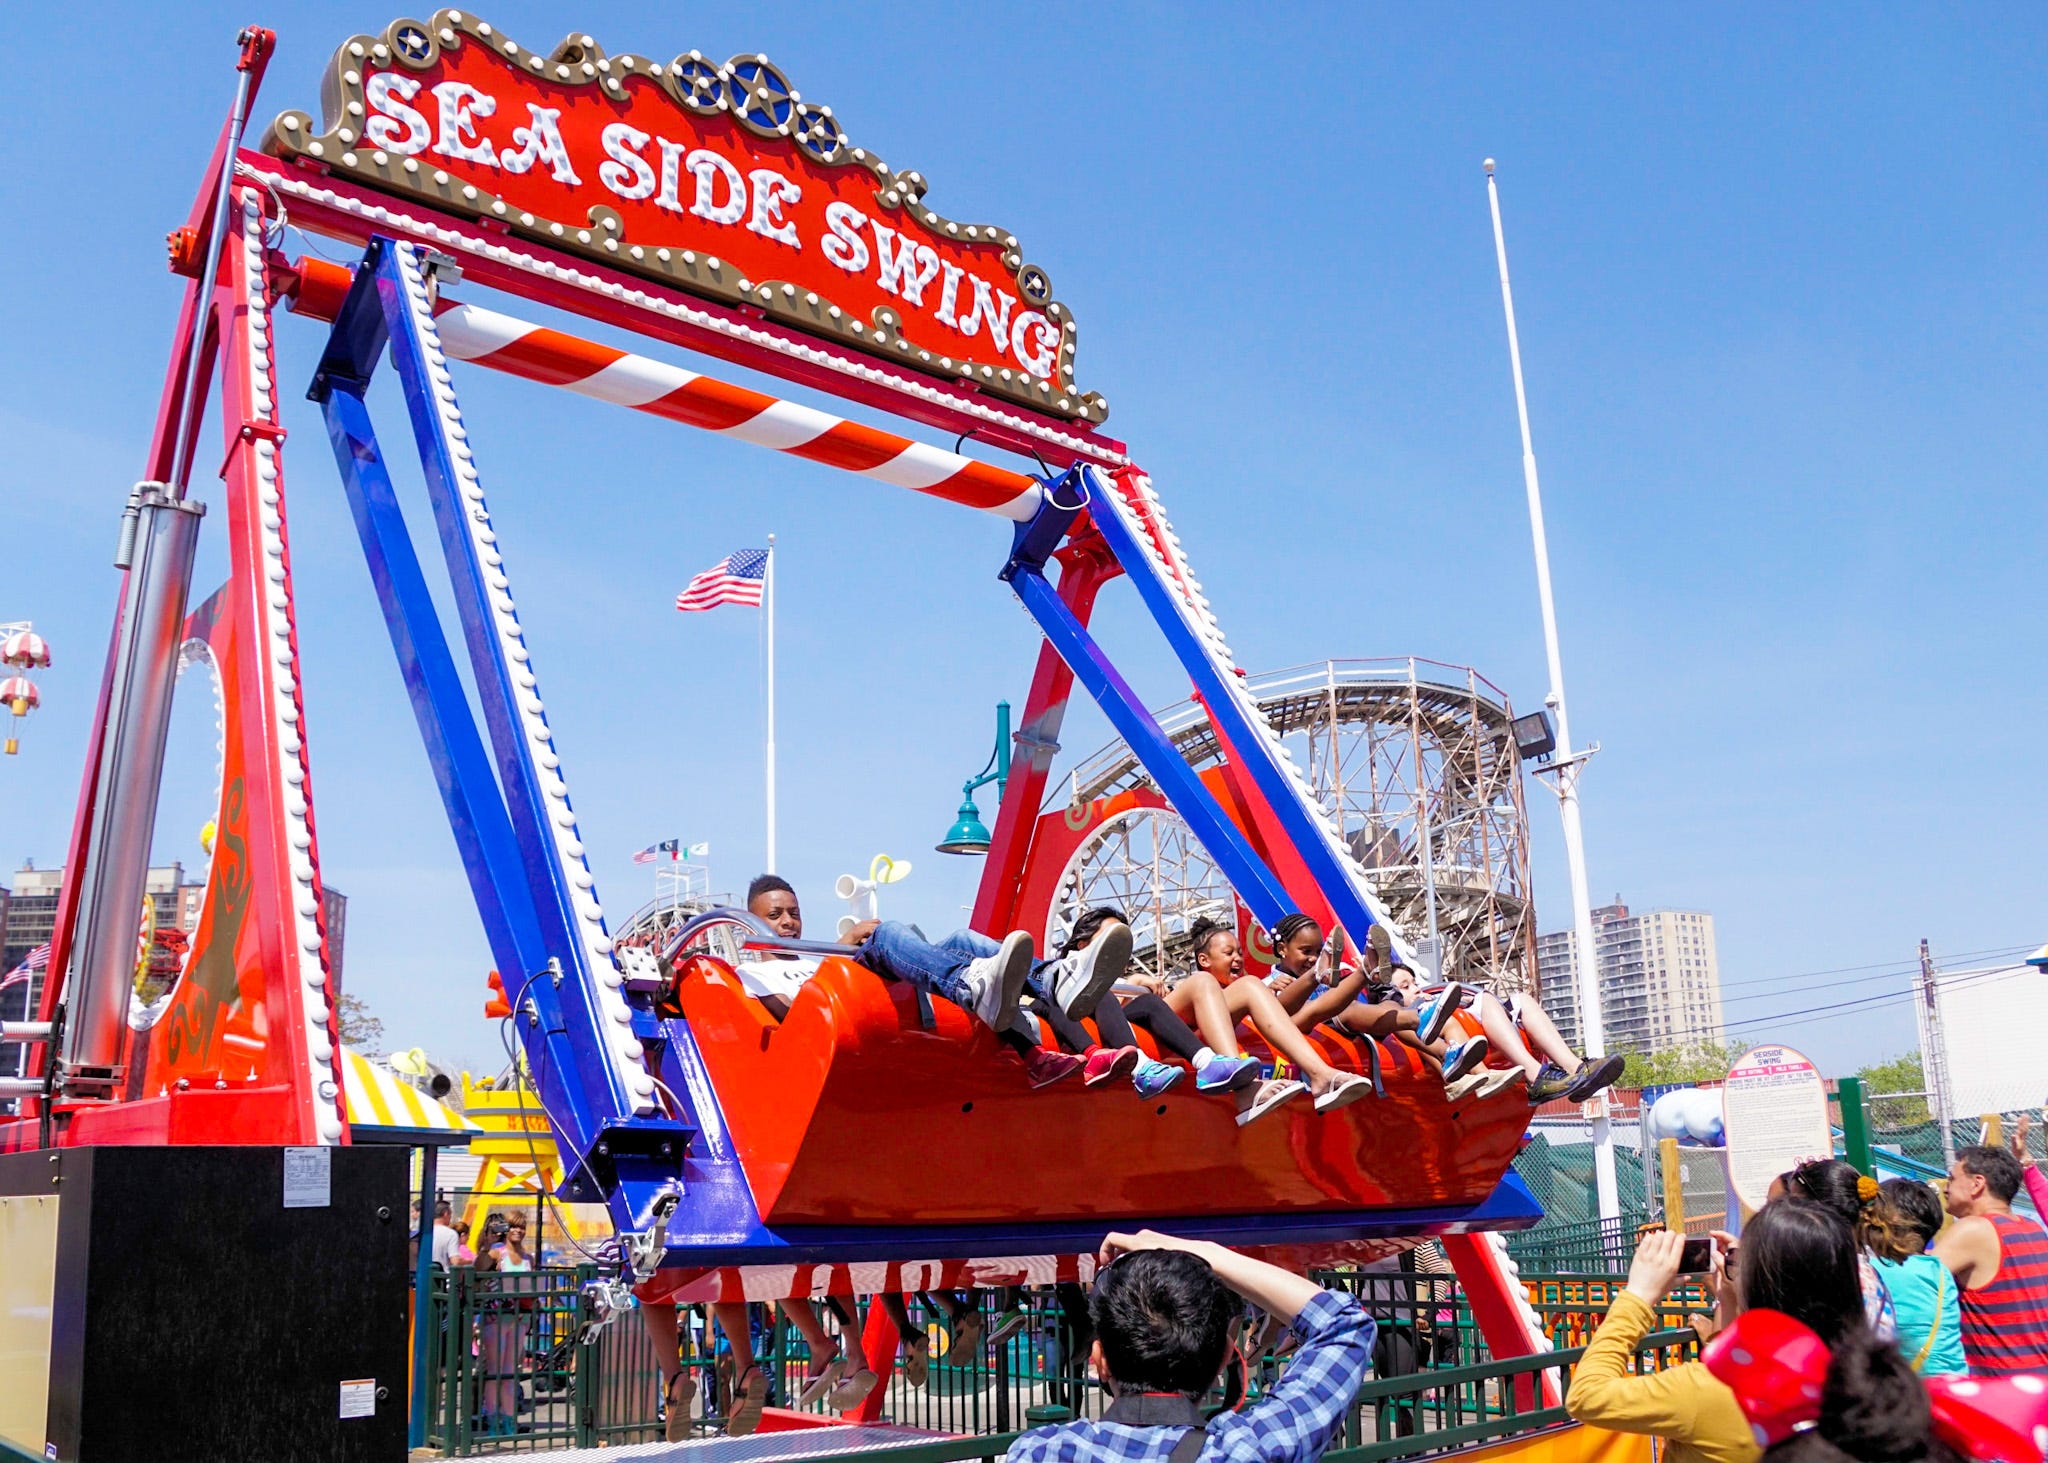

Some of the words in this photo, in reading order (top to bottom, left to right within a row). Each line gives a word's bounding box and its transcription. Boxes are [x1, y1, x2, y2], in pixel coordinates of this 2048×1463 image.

[366, 72, 582, 186] SEA
[599, 122, 802, 250] SIDE
[820, 201, 1061, 379] SWING
[1753, 1049, 1783, 1059] SEASIDE
[1757, 1057, 1781, 1065] SWING
